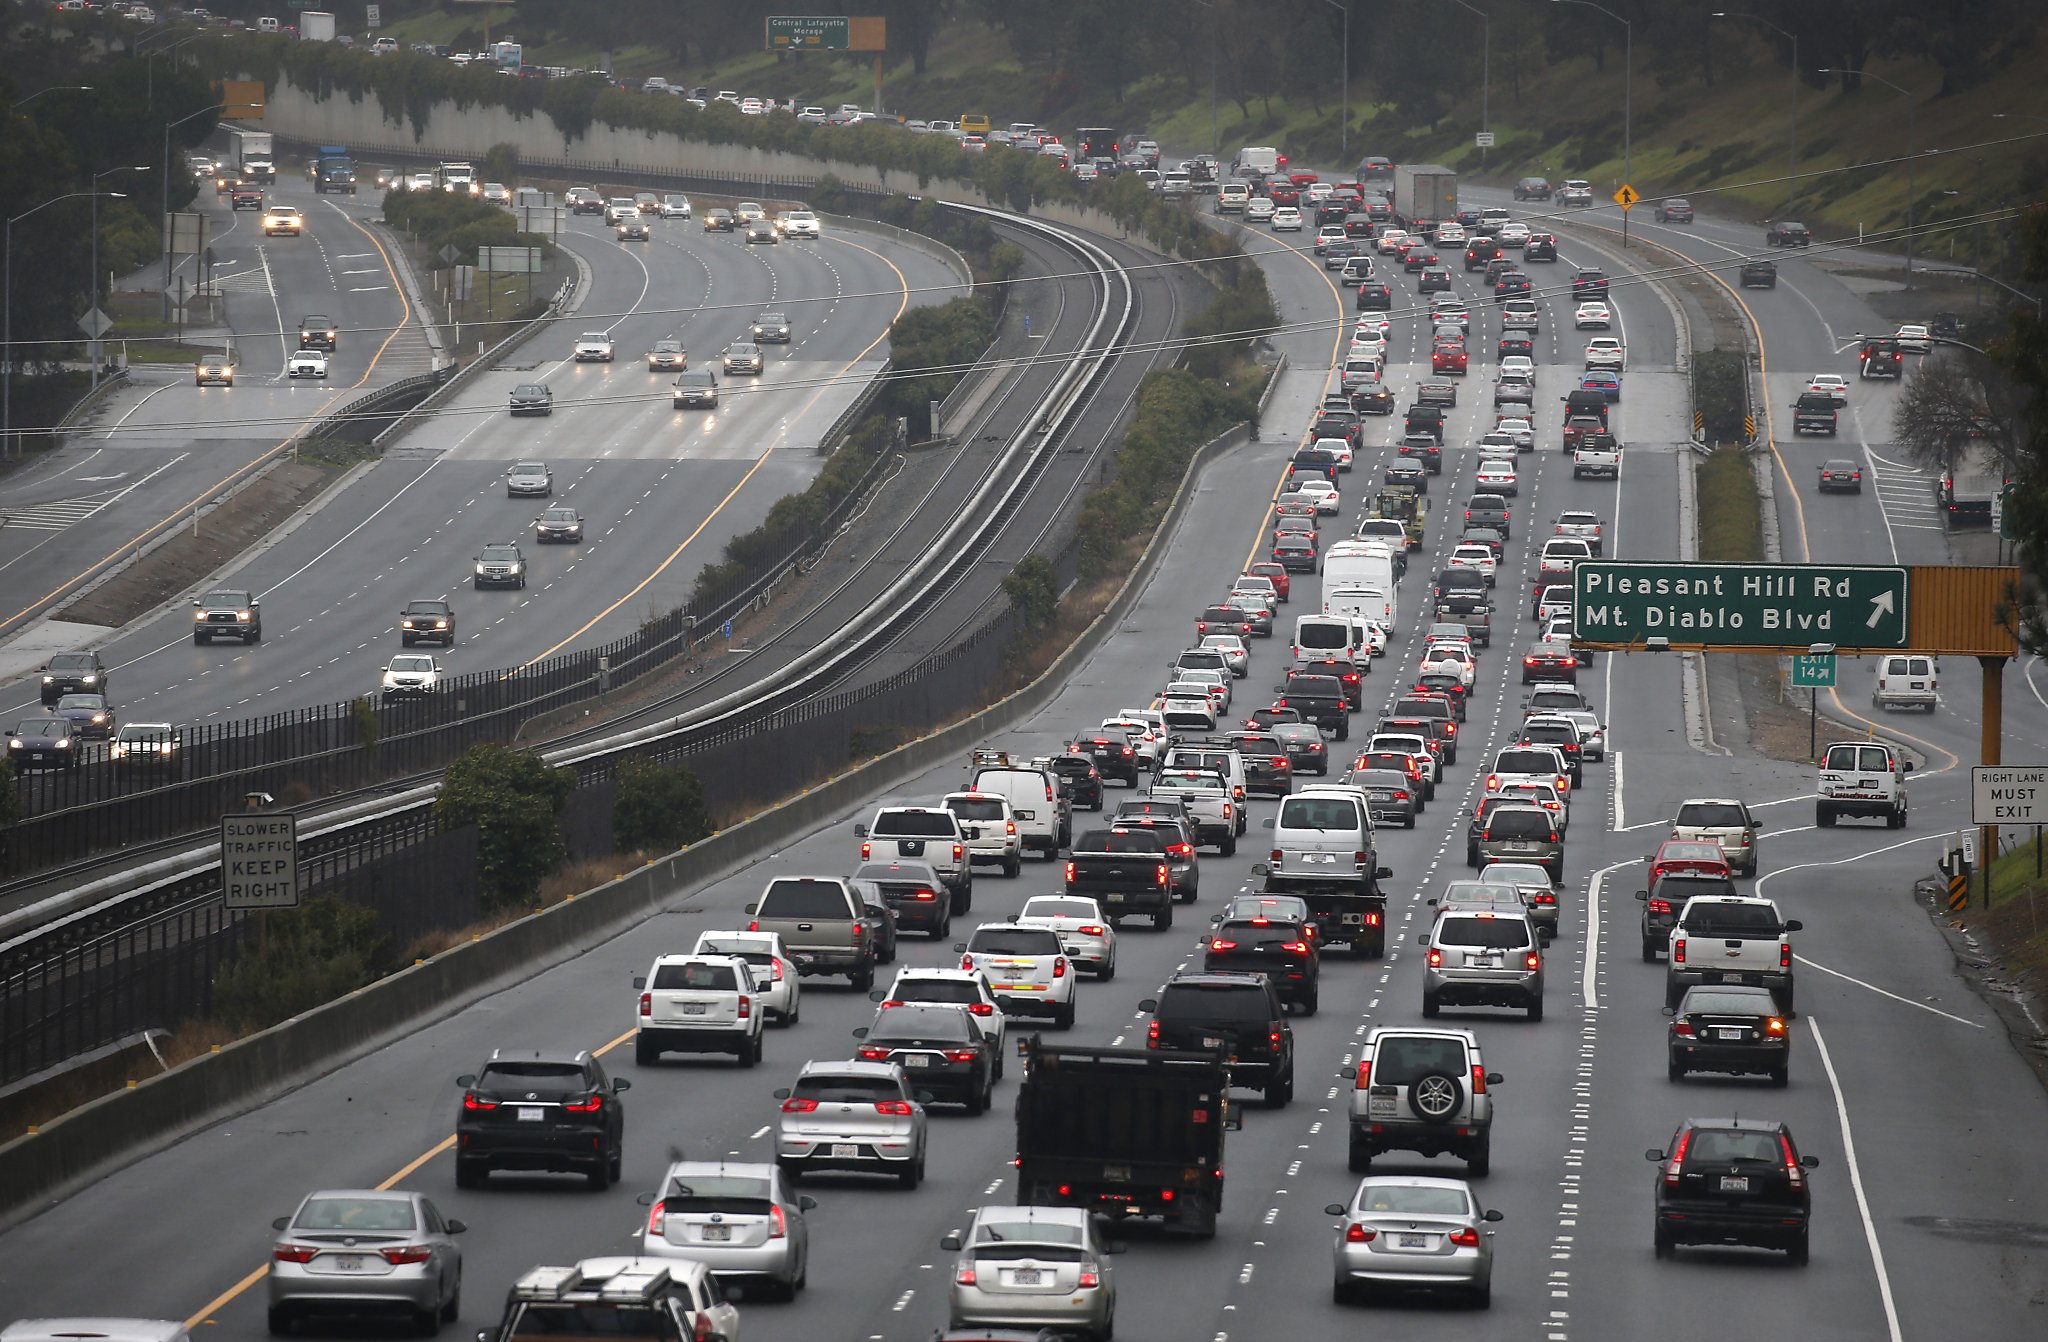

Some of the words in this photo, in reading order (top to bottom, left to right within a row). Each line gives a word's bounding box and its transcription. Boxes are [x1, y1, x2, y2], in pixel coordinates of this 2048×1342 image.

[807, 19, 845, 28] Lafayette
[794, 28, 823, 36] Moraga
[1586, 573, 1723, 596] Pleasant
[1743, 575, 1795, 597] Hill
[1813, 576, 1850, 598] Rd
[1586, 605, 1628, 627] Mt.
[1646, 605, 1744, 628] Diablo
[1762, 608, 1831, 630] Blvd
[1800, 655, 1829, 664] EXIT
[1801, 666, 1816, 678] 14
[1981, 774, 2013, 783] RIGHT
[2017, 774, 2045, 783] LANE
[1991, 789, 2036, 800] MUST
[1995, 806, 2032, 818] EXIT
[227, 823, 289, 836] SLOWER
[226, 841, 292, 853] TRAFFIC
[232, 860, 287, 876] KEEP
[231, 882, 290, 898] RIGHT
